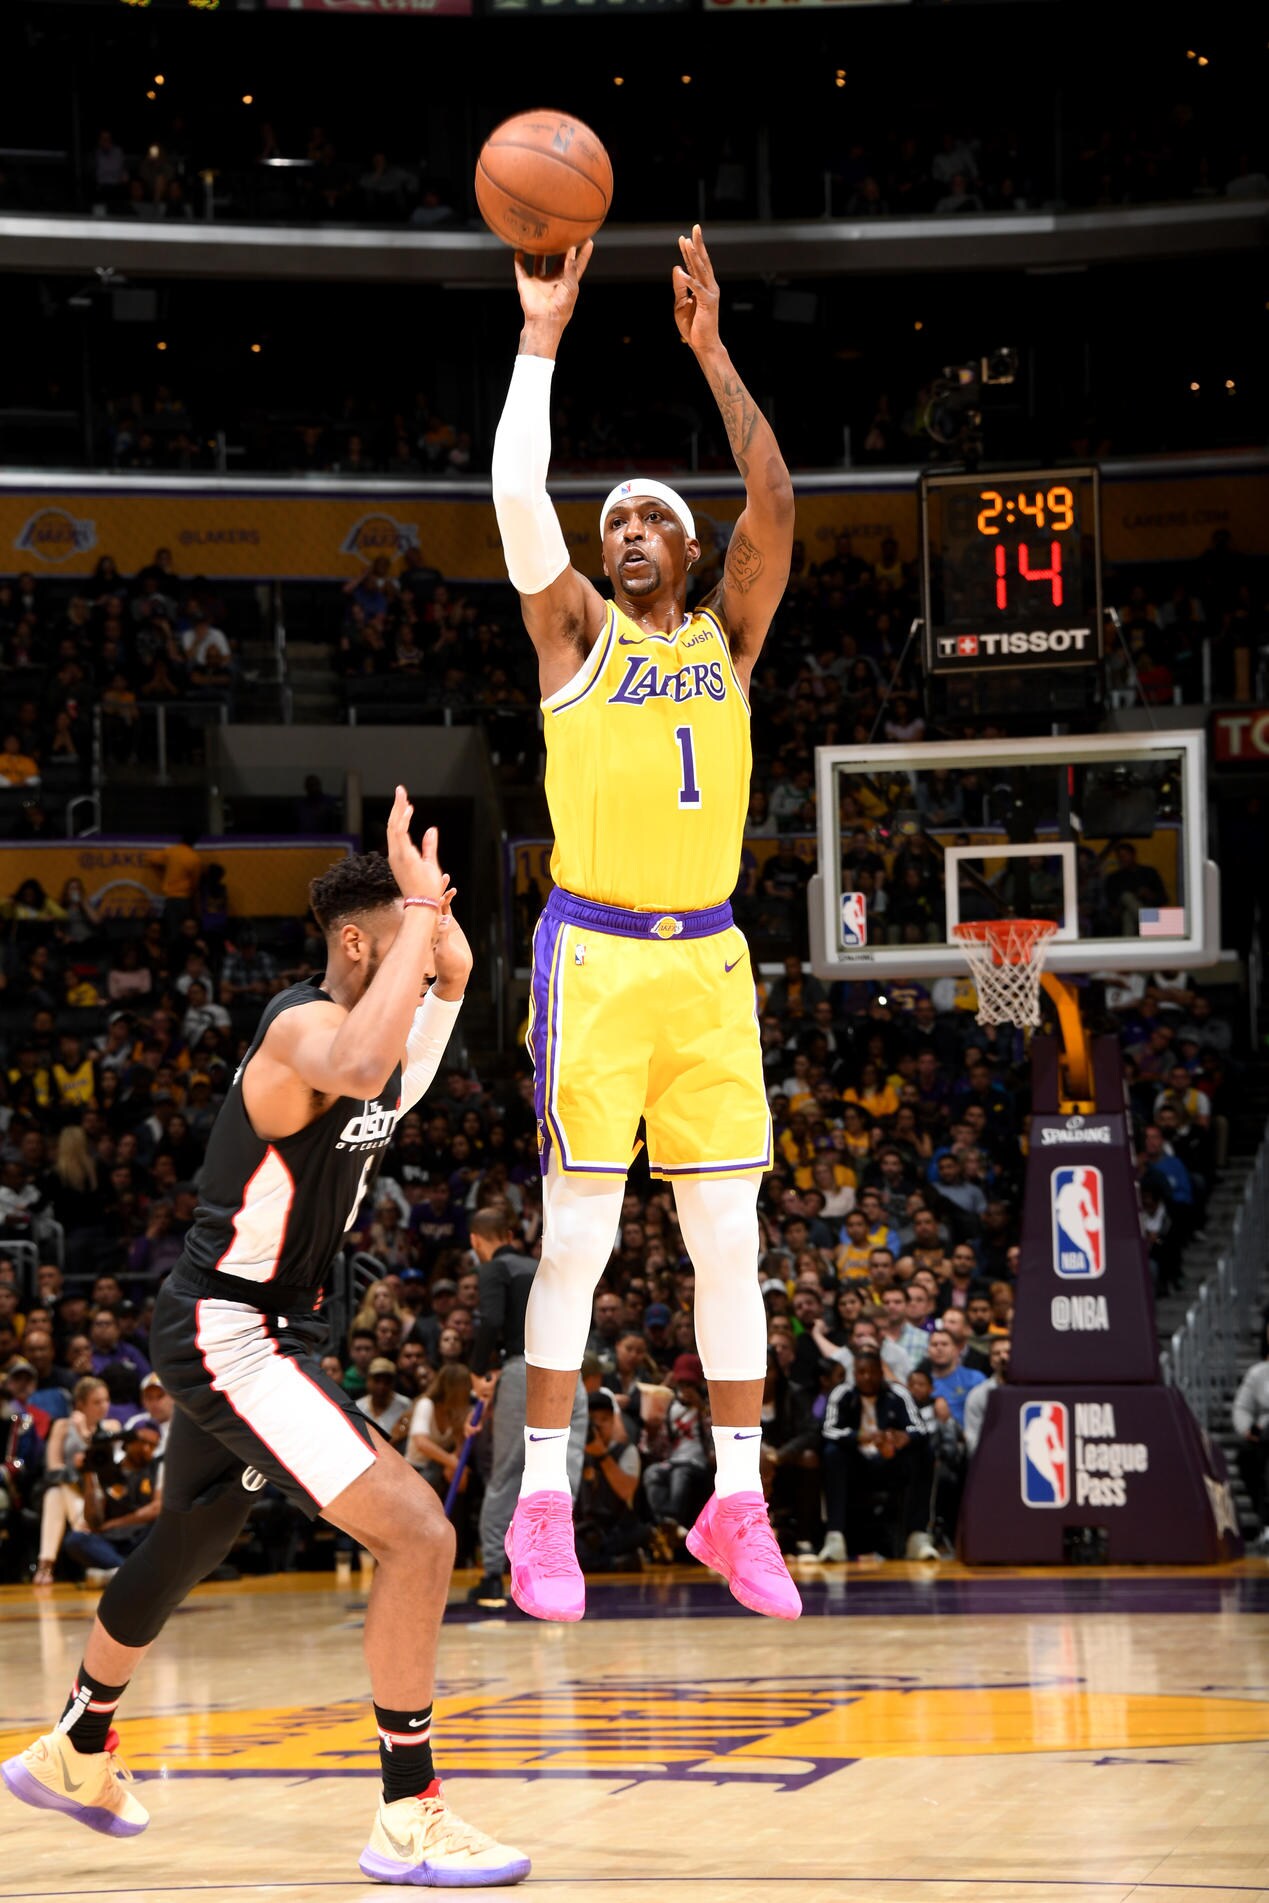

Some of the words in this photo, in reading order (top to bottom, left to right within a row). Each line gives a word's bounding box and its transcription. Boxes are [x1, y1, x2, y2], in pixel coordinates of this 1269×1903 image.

[977, 486, 1074, 535] 2:49
[995, 541, 1063, 610] 14
[681, 630, 714, 648] wish
[979, 628, 1091, 655] TISSOT
[674, 724, 702, 809] 1
[80, 852, 146, 869] @LAKE
[1041, 1126, 1112, 1145] SPALDING
[1050, 1295, 1110, 1331] @NBA
[1074, 1403, 1116, 1438] NBA
[1075, 1437, 1149, 1477] League
[1076, 1472, 1127, 1507] Pass
